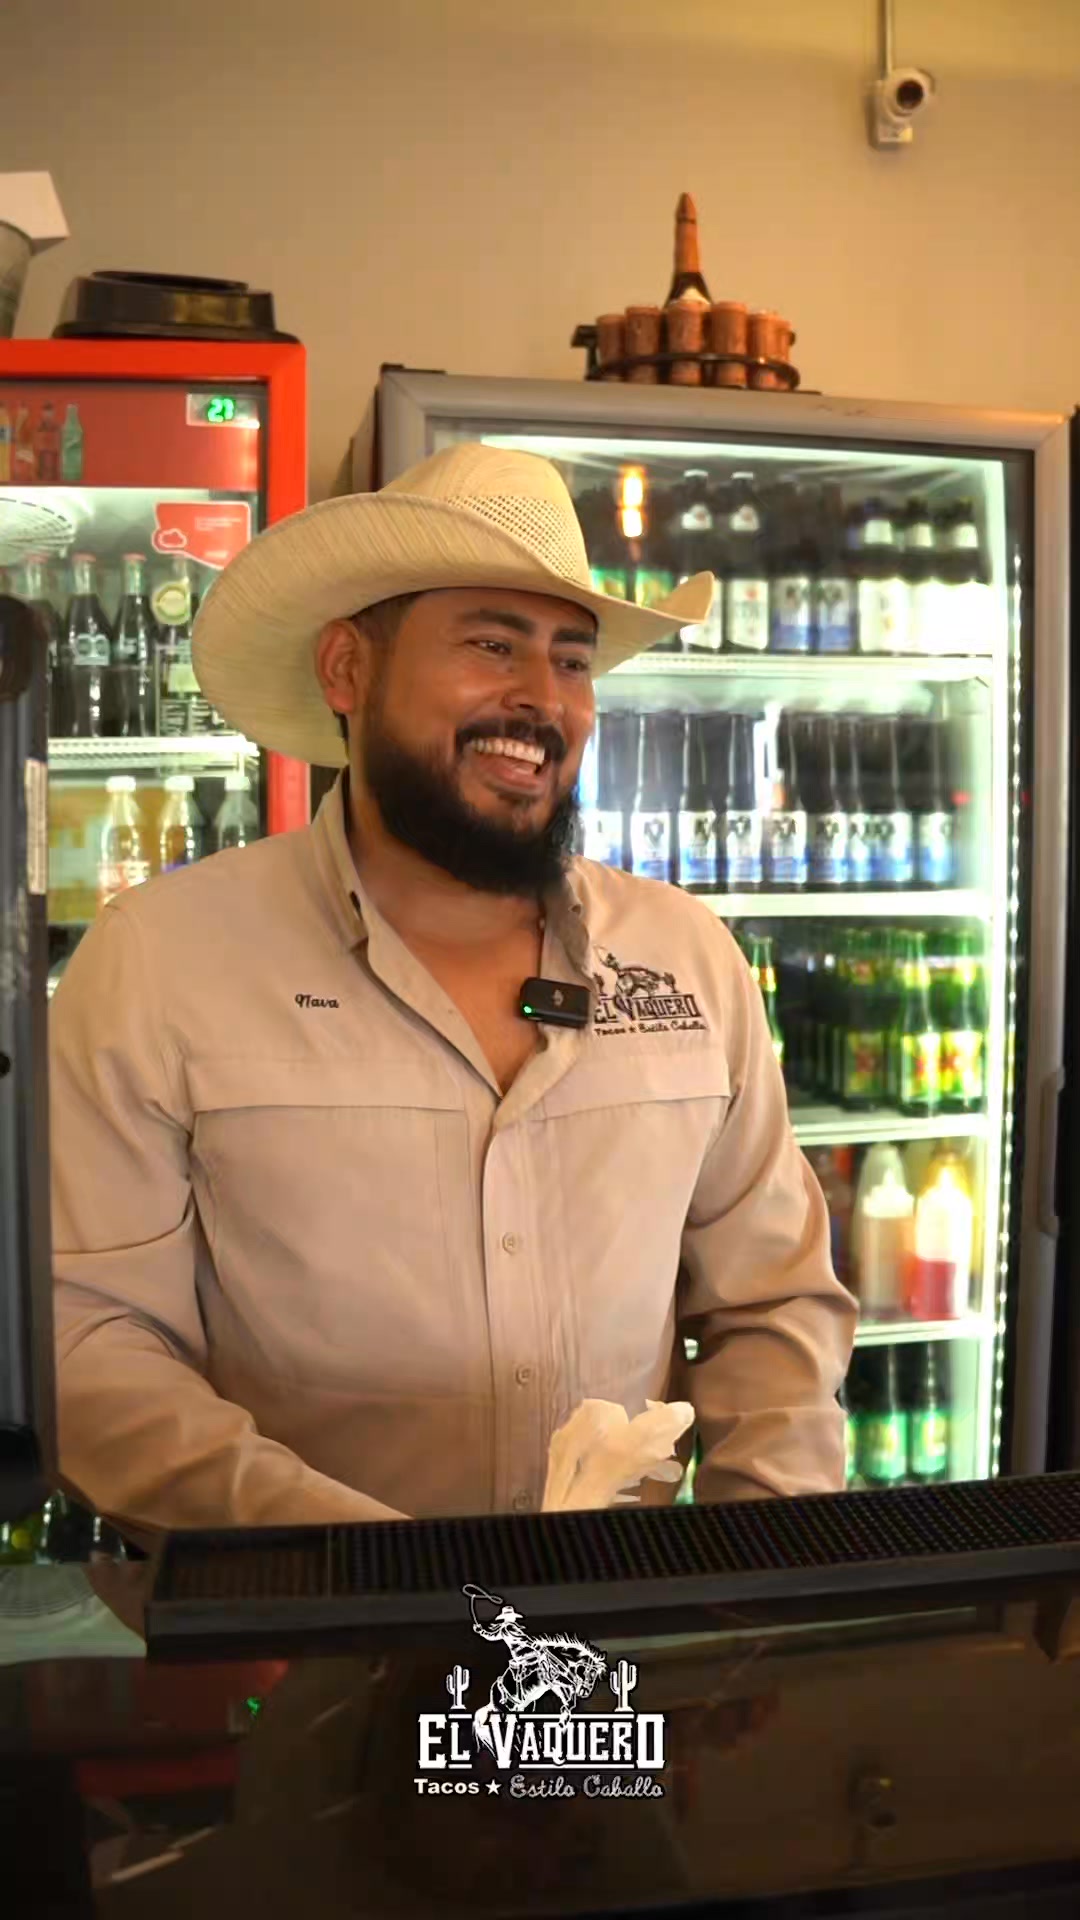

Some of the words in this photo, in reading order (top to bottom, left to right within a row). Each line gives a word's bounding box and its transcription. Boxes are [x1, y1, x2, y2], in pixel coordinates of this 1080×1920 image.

[294, 993, 339, 1008] Nava
[616, 994, 702, 1021] VAQUERO
[594, 1027, 626, 1037] Tacos
[638, 1022, 670, 1034] Estilo
[670, 1019, 707, 1031] Caballo
